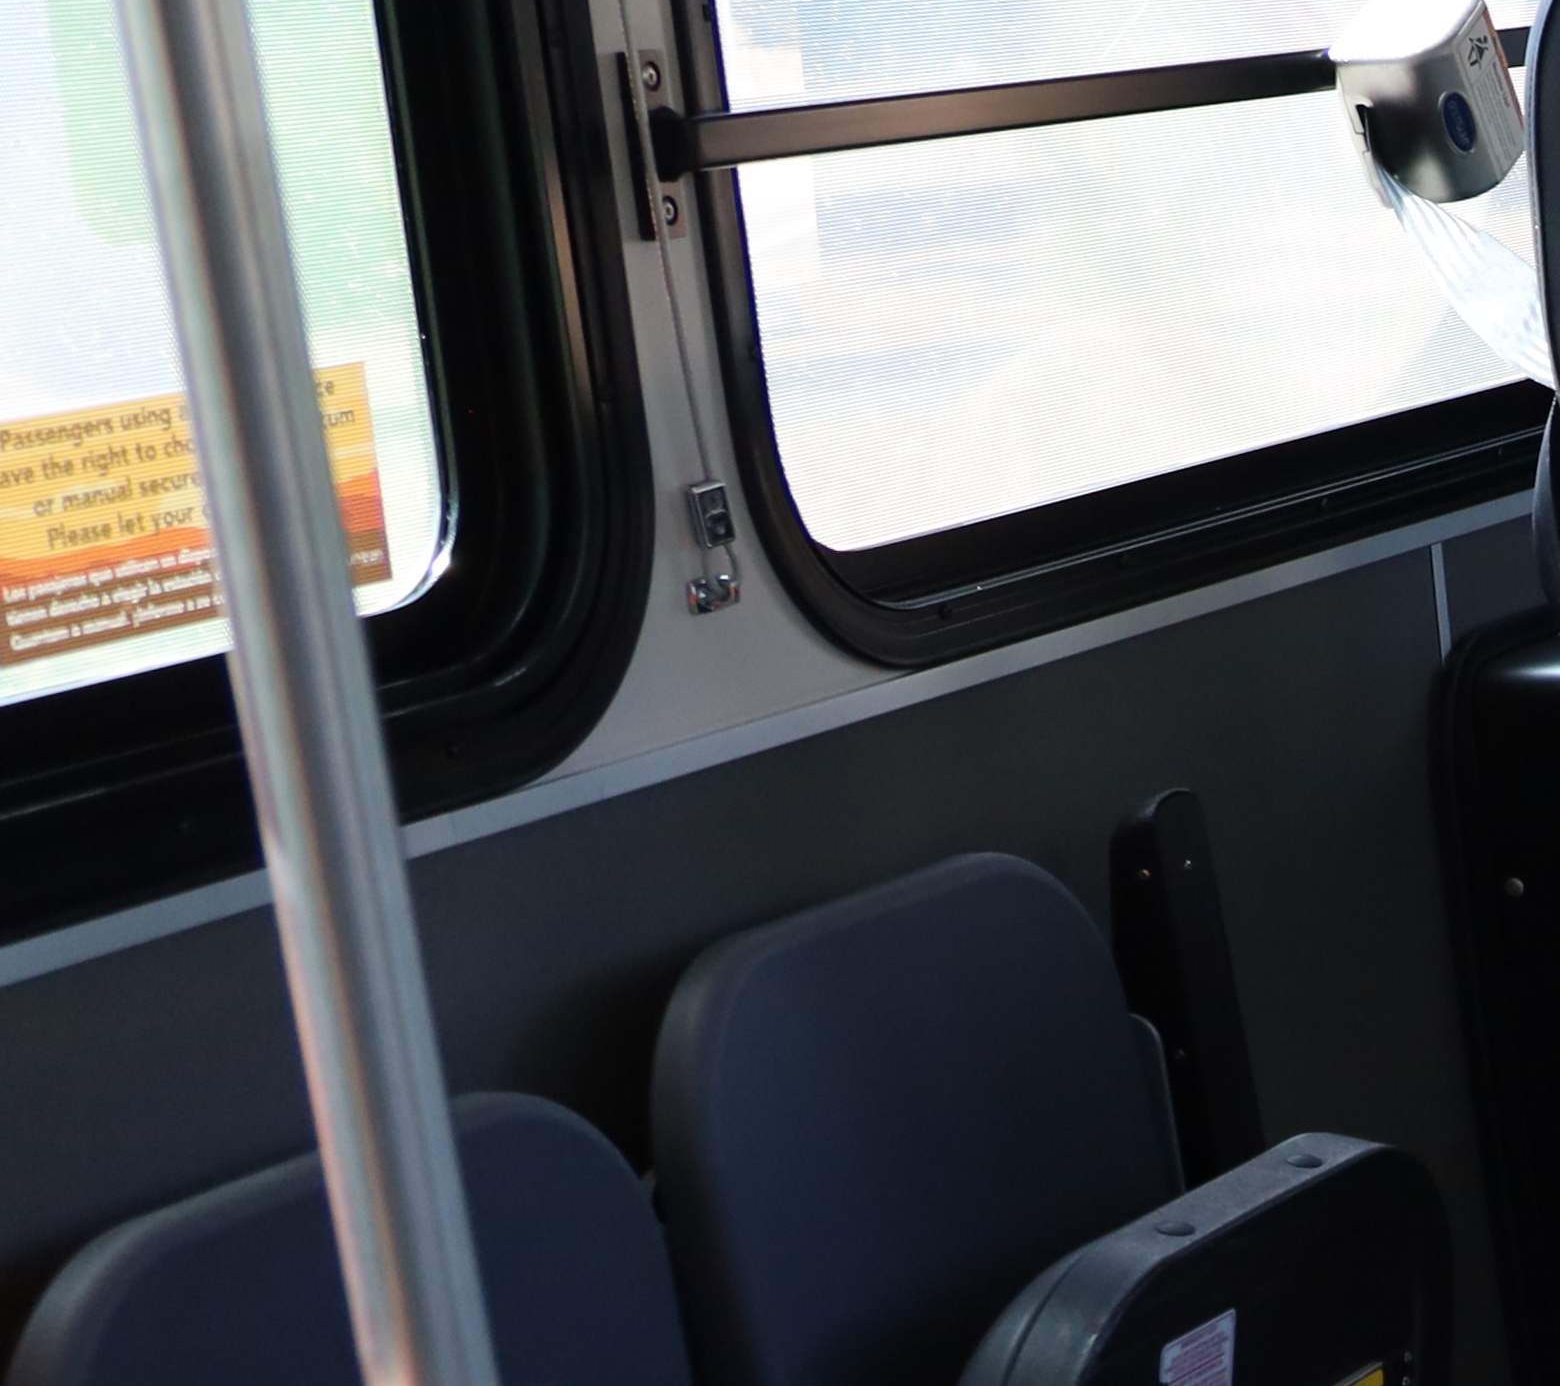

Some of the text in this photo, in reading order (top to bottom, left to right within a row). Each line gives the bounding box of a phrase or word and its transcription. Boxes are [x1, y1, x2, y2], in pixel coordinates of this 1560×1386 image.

[1, 406, 172, 451] Passengers using
[41, 437, 157, 480] the right to
[61, 478, 134, 512] manual
[46, 520, 112, 551] Please
